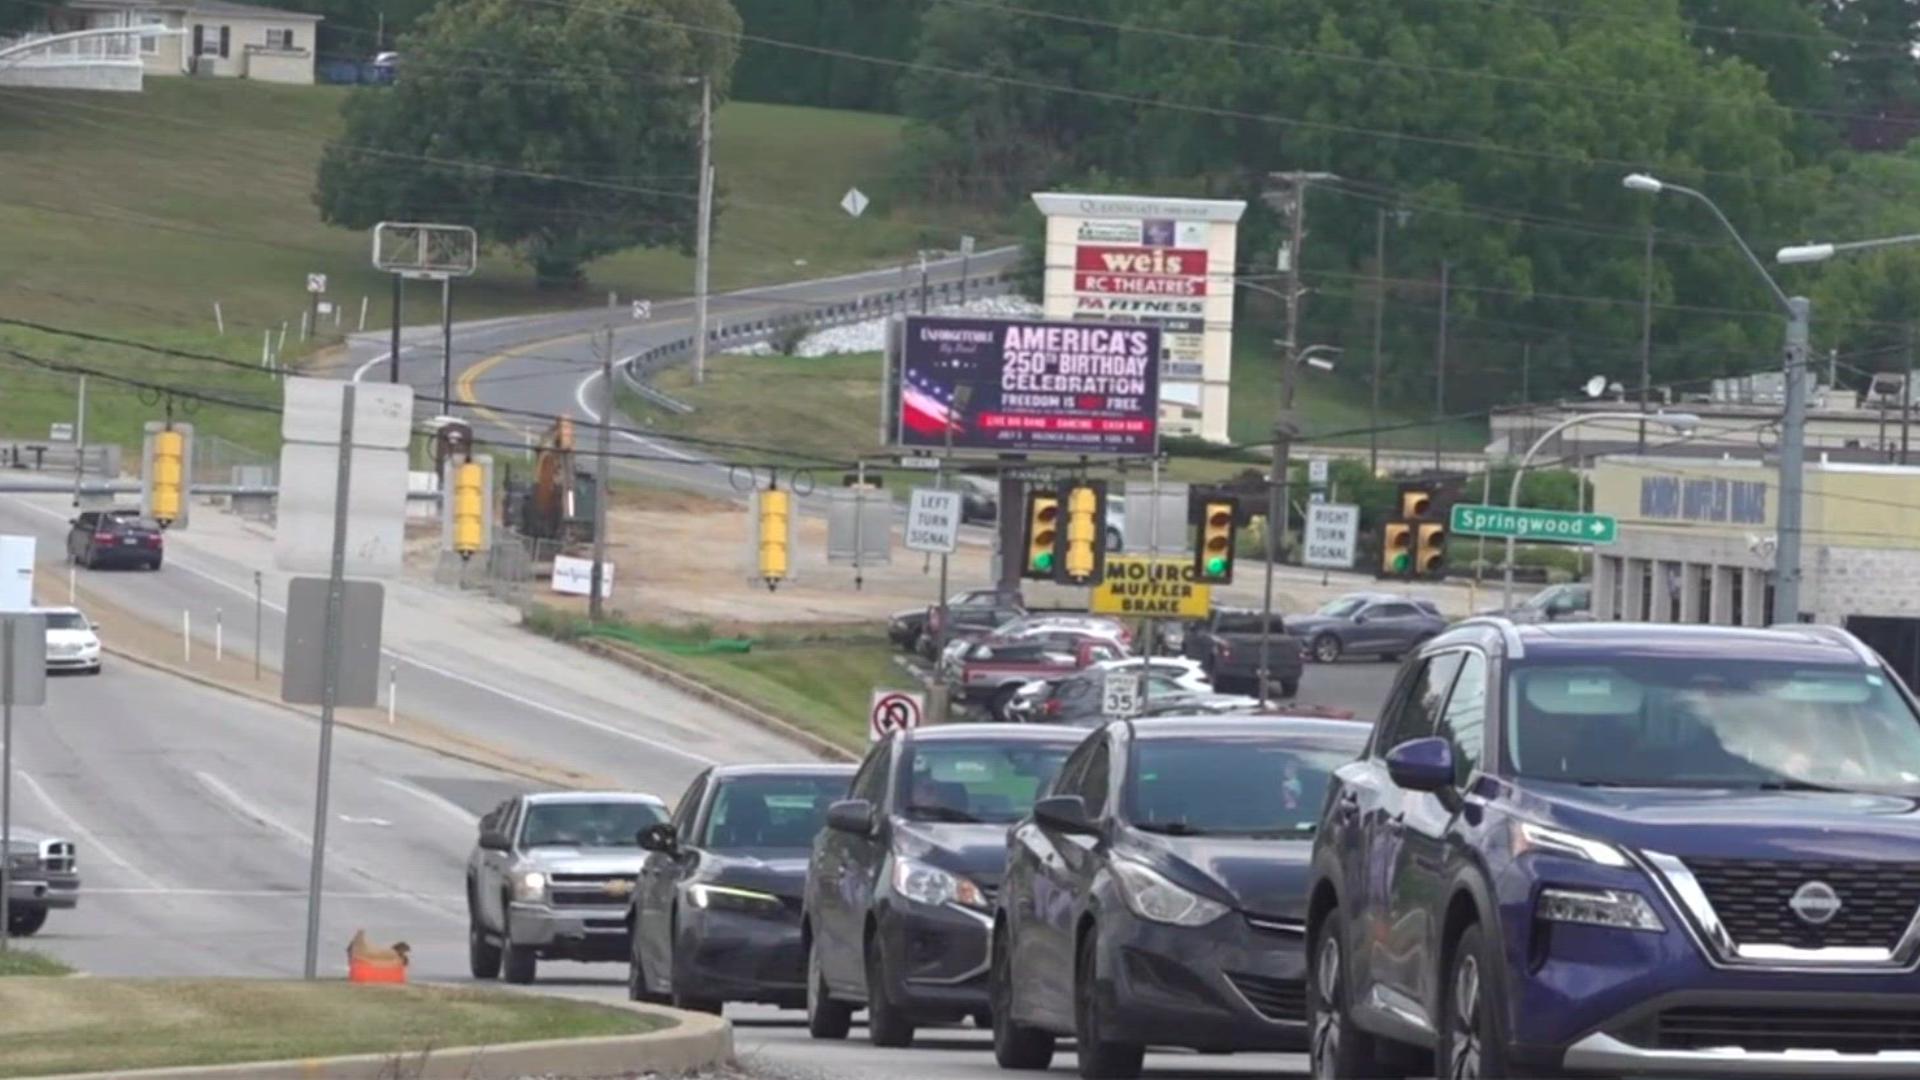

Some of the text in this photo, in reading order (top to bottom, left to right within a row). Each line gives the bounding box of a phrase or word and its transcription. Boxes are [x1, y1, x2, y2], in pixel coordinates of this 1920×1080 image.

[1102, 250, 1182, 273] weis
[1085, 276, 1195, 294] RC THEATRES
[1078, 297, 1203, 312] PA FITNESS
[1003, 325, 1148, 355] AMERICA'S
[1060, 353, 1149, 376] BIRTHDAY
[1000, 373, 1146, 395] CELEBRATION
[1001, 393, 1060, 408] FREEDOM
[1063, 395, 1075, 408] IS
[920, 495, 949, 509] LEFT
[918, 512, 948, 526] TURN
[1315, 509, 1349, 524] RIGHT
[1461, 510, 1584, 535] Springwood
[910, 530, 950, 546] SIGNAL
[1315, 527, 1347, 541] TURN
[1308, 545, 1349, 560] SIGNAL
[1110, 582, 1193, 599] MUFFLER
[1121, 598, 1180, 613] BRAKE
[1107, 694, 1133, 711] 35
